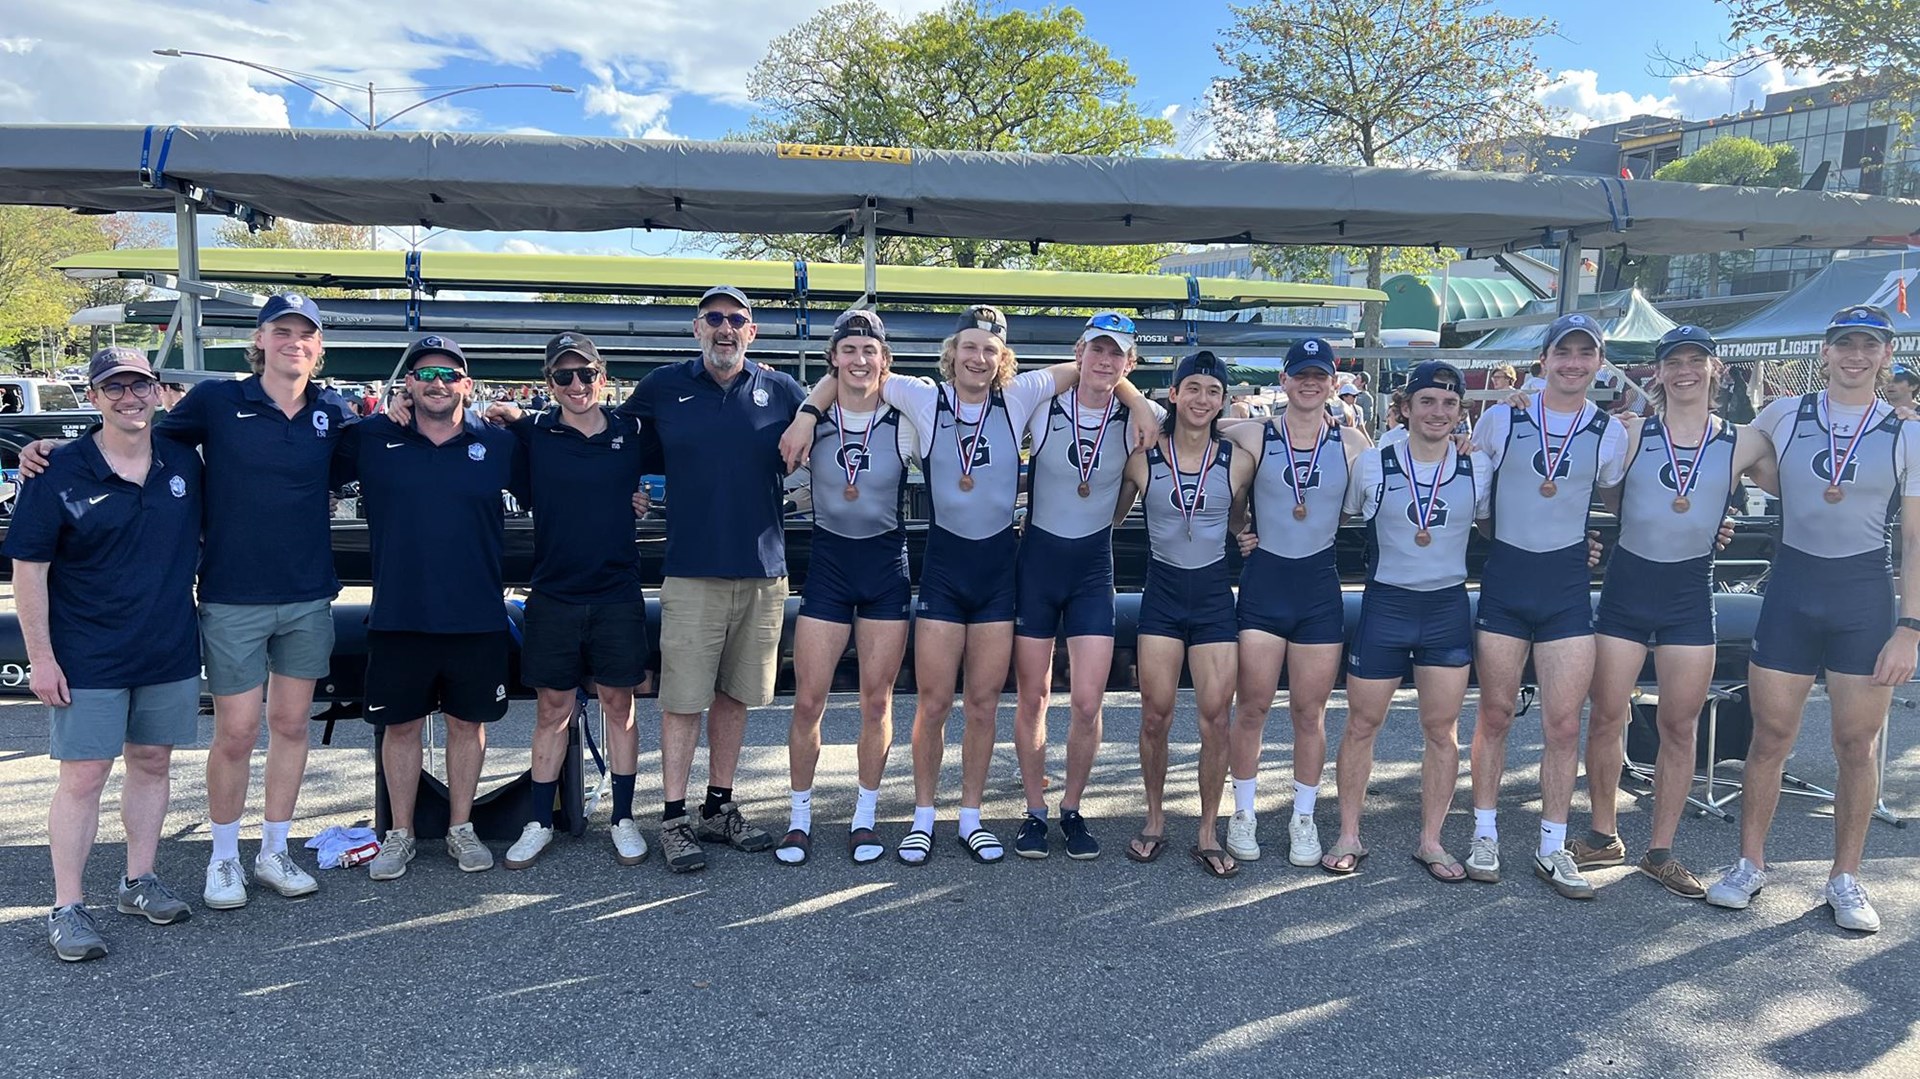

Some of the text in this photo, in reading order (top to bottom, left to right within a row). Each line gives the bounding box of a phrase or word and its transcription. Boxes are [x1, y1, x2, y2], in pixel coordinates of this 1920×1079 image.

[1715, 342, 1777, 357] ARTMOUTH
[313, 410, 329, 431] G
[835, 441, 872, 473] G
[956, 433, 992, 468] G
[1066, 438, 1103, 471] G
[1531, 446, 1573, 480] G
[1810, 446, 1861, 484] G
[1281, 461, 1323, 490] G
[1657, 458, 1702, 492] G
[1169, 482, 1208, 512] G
[1405, 495, 1451, 529] G
